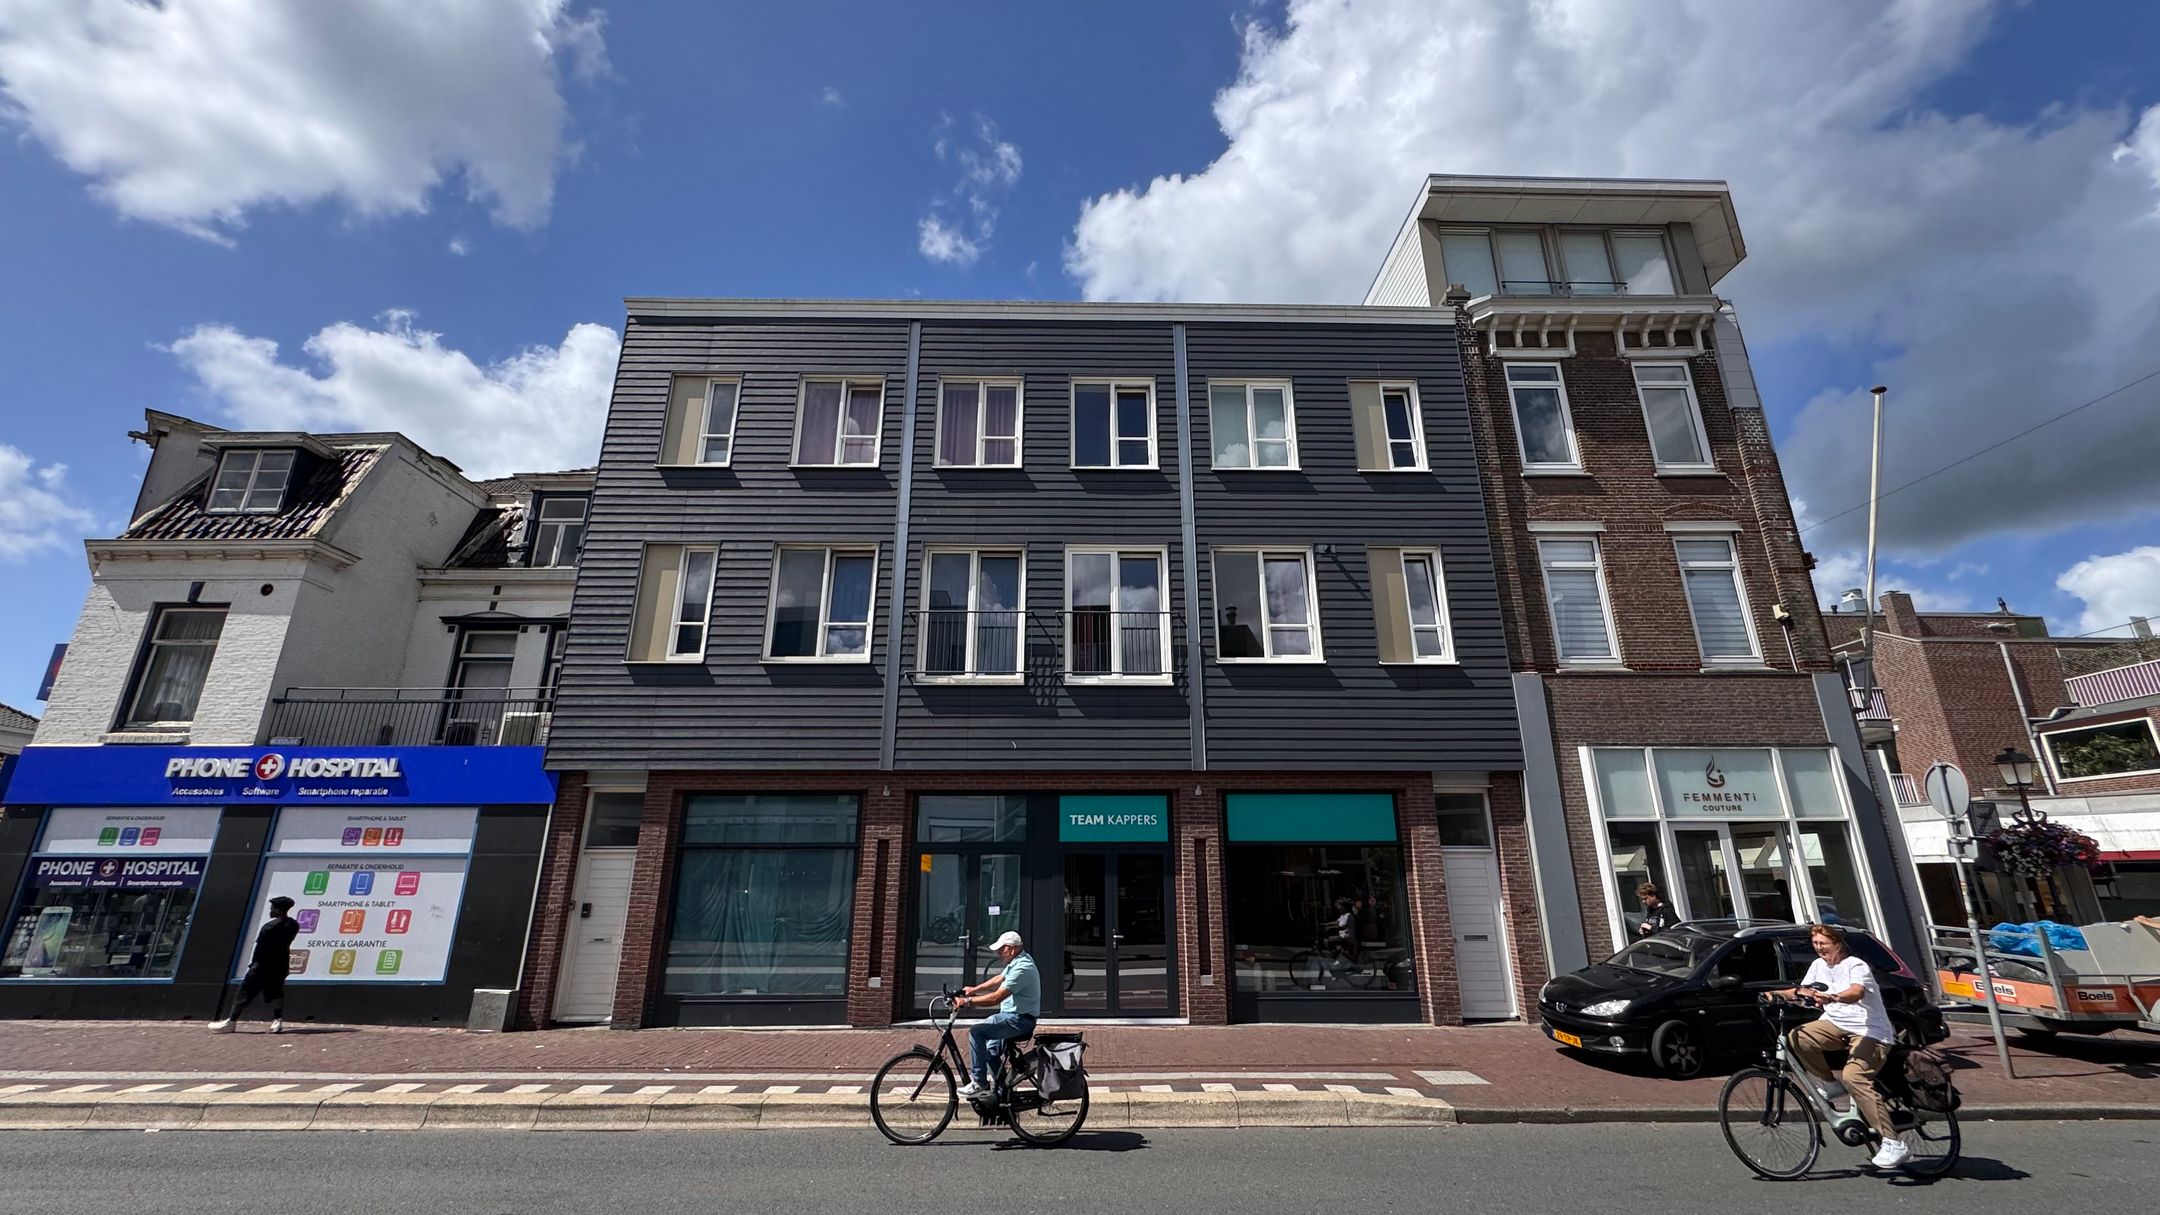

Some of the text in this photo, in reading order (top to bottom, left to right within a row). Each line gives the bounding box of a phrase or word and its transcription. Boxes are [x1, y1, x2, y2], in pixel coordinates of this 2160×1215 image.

[164, 757, 402, 778] PHONE HOSPITAL
[172, 787, 389, 797] Accessoires Software Smartphone reparatie
[1702, 804, 1743, 812] COUTURE
[1069, 814, 1158, 825] TEAM KAPPERS
[37, 861, 200, 875] PHONE HOSPITAL
[307, 940, 388, 948] SERVICE & GARANTIE
[1975, 982, 2015, 996] Bels
[2077, 991, 2114, 1001] Boels
